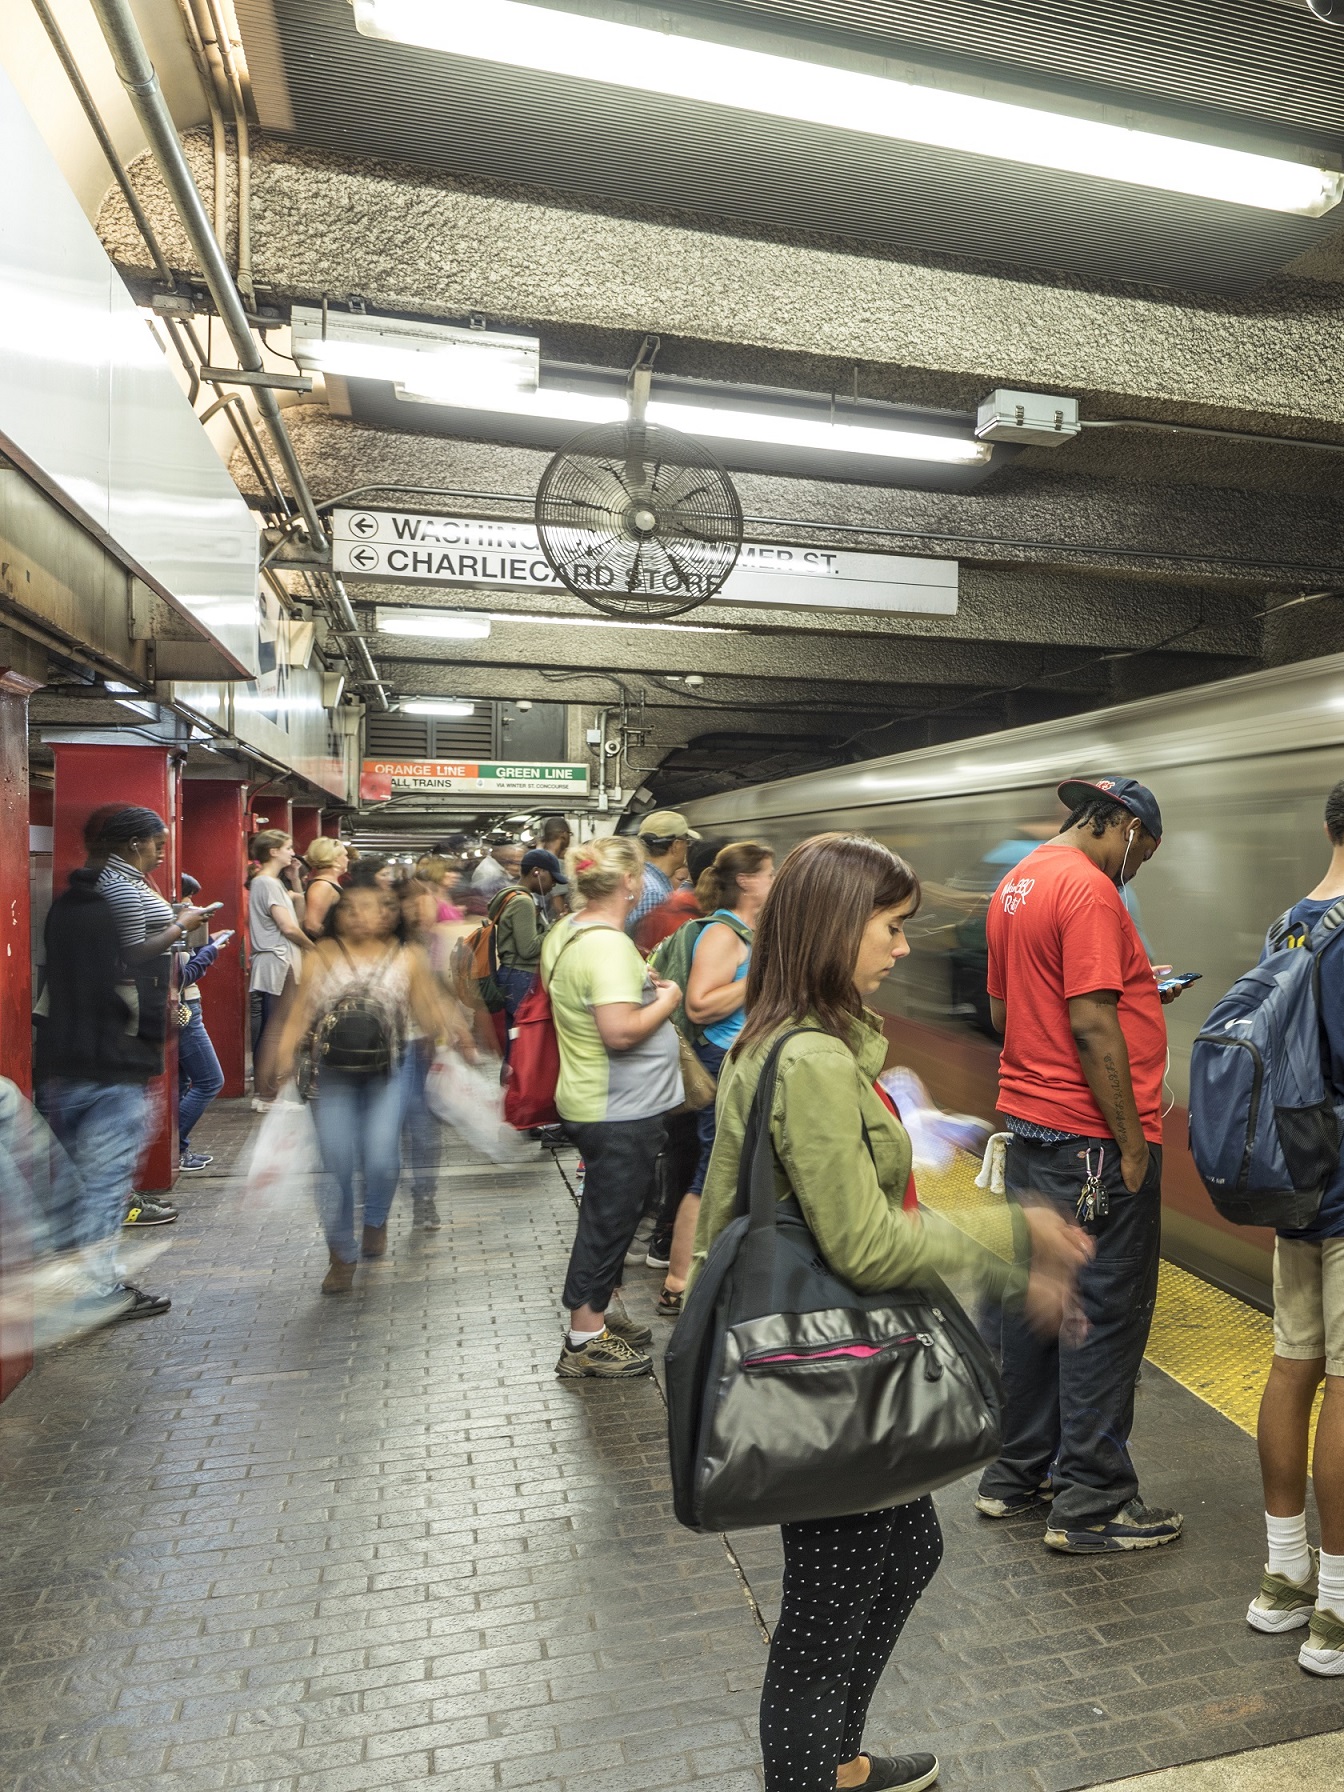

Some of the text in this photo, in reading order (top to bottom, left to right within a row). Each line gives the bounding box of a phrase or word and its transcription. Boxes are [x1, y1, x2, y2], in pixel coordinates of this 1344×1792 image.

[803, 552, 839, 574] ST.
[375, 764, 466, 777] ORANGE LINE
[496, 767, 573, 780] GREEN LINE
[391, 775, 452, 788] ALL TRAINS
